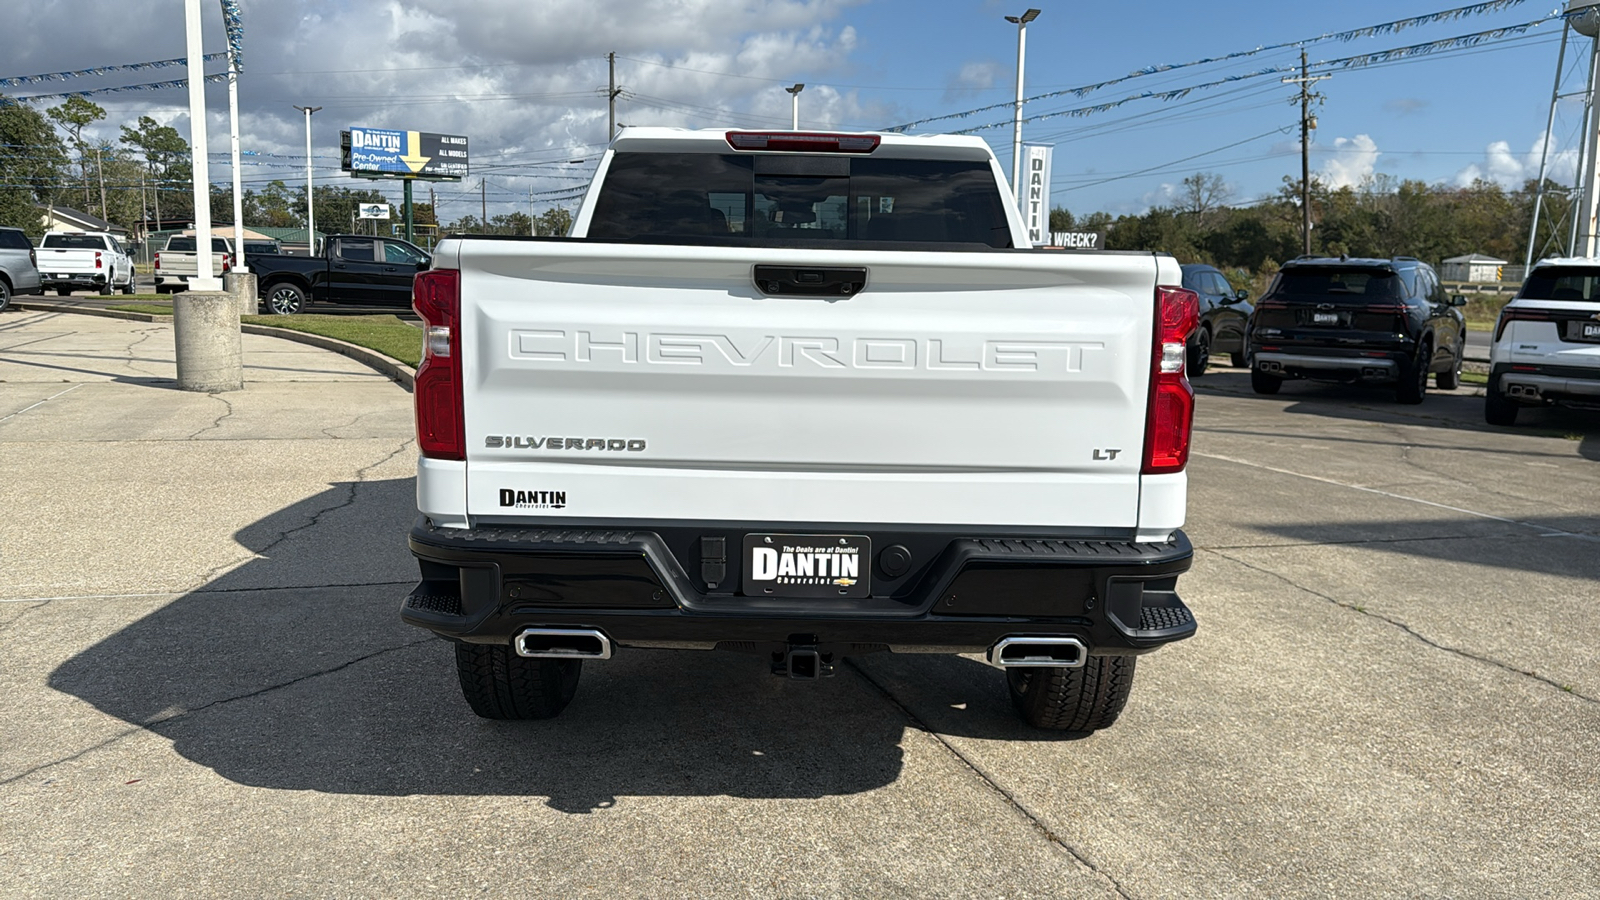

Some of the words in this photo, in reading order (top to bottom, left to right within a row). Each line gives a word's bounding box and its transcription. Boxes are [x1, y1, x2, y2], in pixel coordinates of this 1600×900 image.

[352, 130, 400, 148] DANTIN
[450, 137, 467, 145] MAKES
[353, 152, 397, 164] Pre-Owned
[448, 150, 467, 158] MODELS
[353, 161, 380, 170] Center
[1029, 158, 1042, 242] DANTIN
[1054, 232, 1098, 248] WRECK?
[507, 328, 1105, 373] CHEVROLET
[485, 435, 646, 452] SILVERADO
[1092, 449, 1122, 461] LT
[499, 488, 566, 507] DANTIN
[752, 547, 859, 580] DANTIN
[777, 576, 830, 585] Chevrolet
